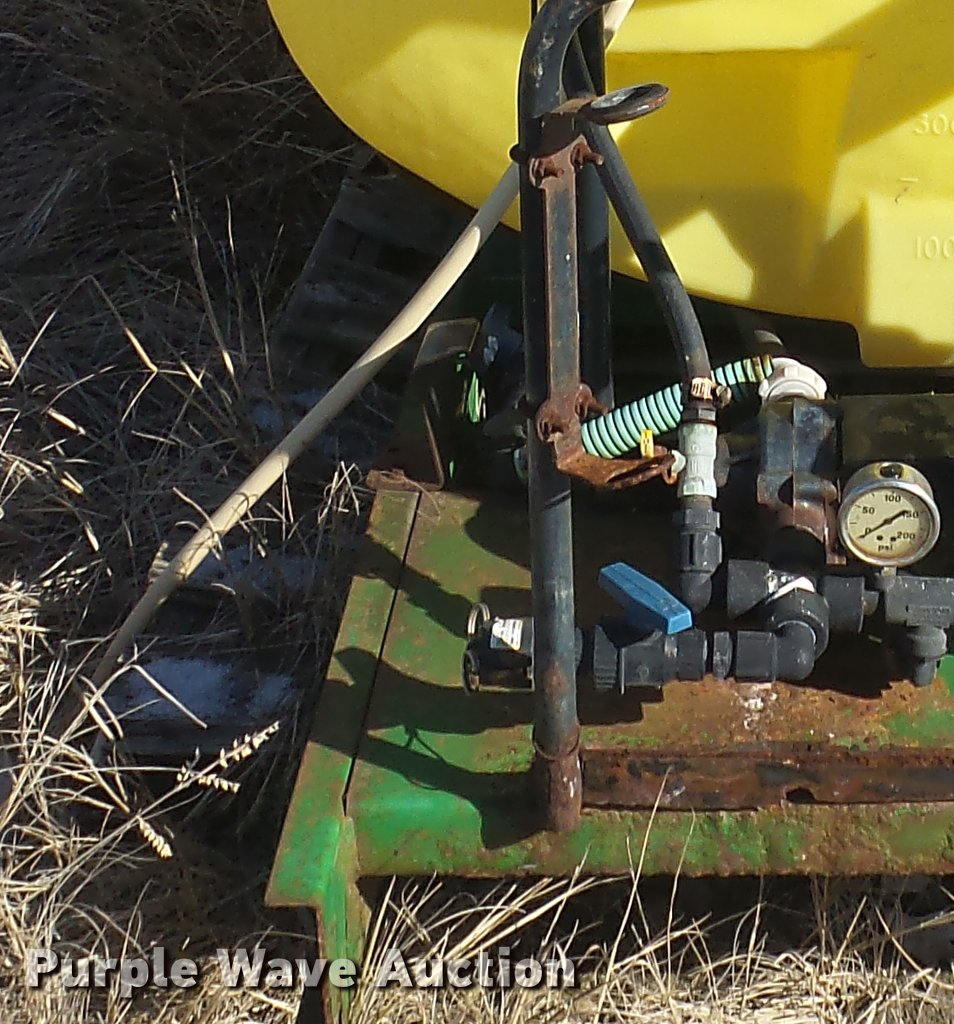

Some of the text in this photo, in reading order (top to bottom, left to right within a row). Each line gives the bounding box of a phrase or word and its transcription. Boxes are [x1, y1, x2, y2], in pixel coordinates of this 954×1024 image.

[884, 494, 902, 503] 100
[862, 506, 875, 515] 50
[896, 531, 916, 540] 200
[877, 544, 894, 553] psi
